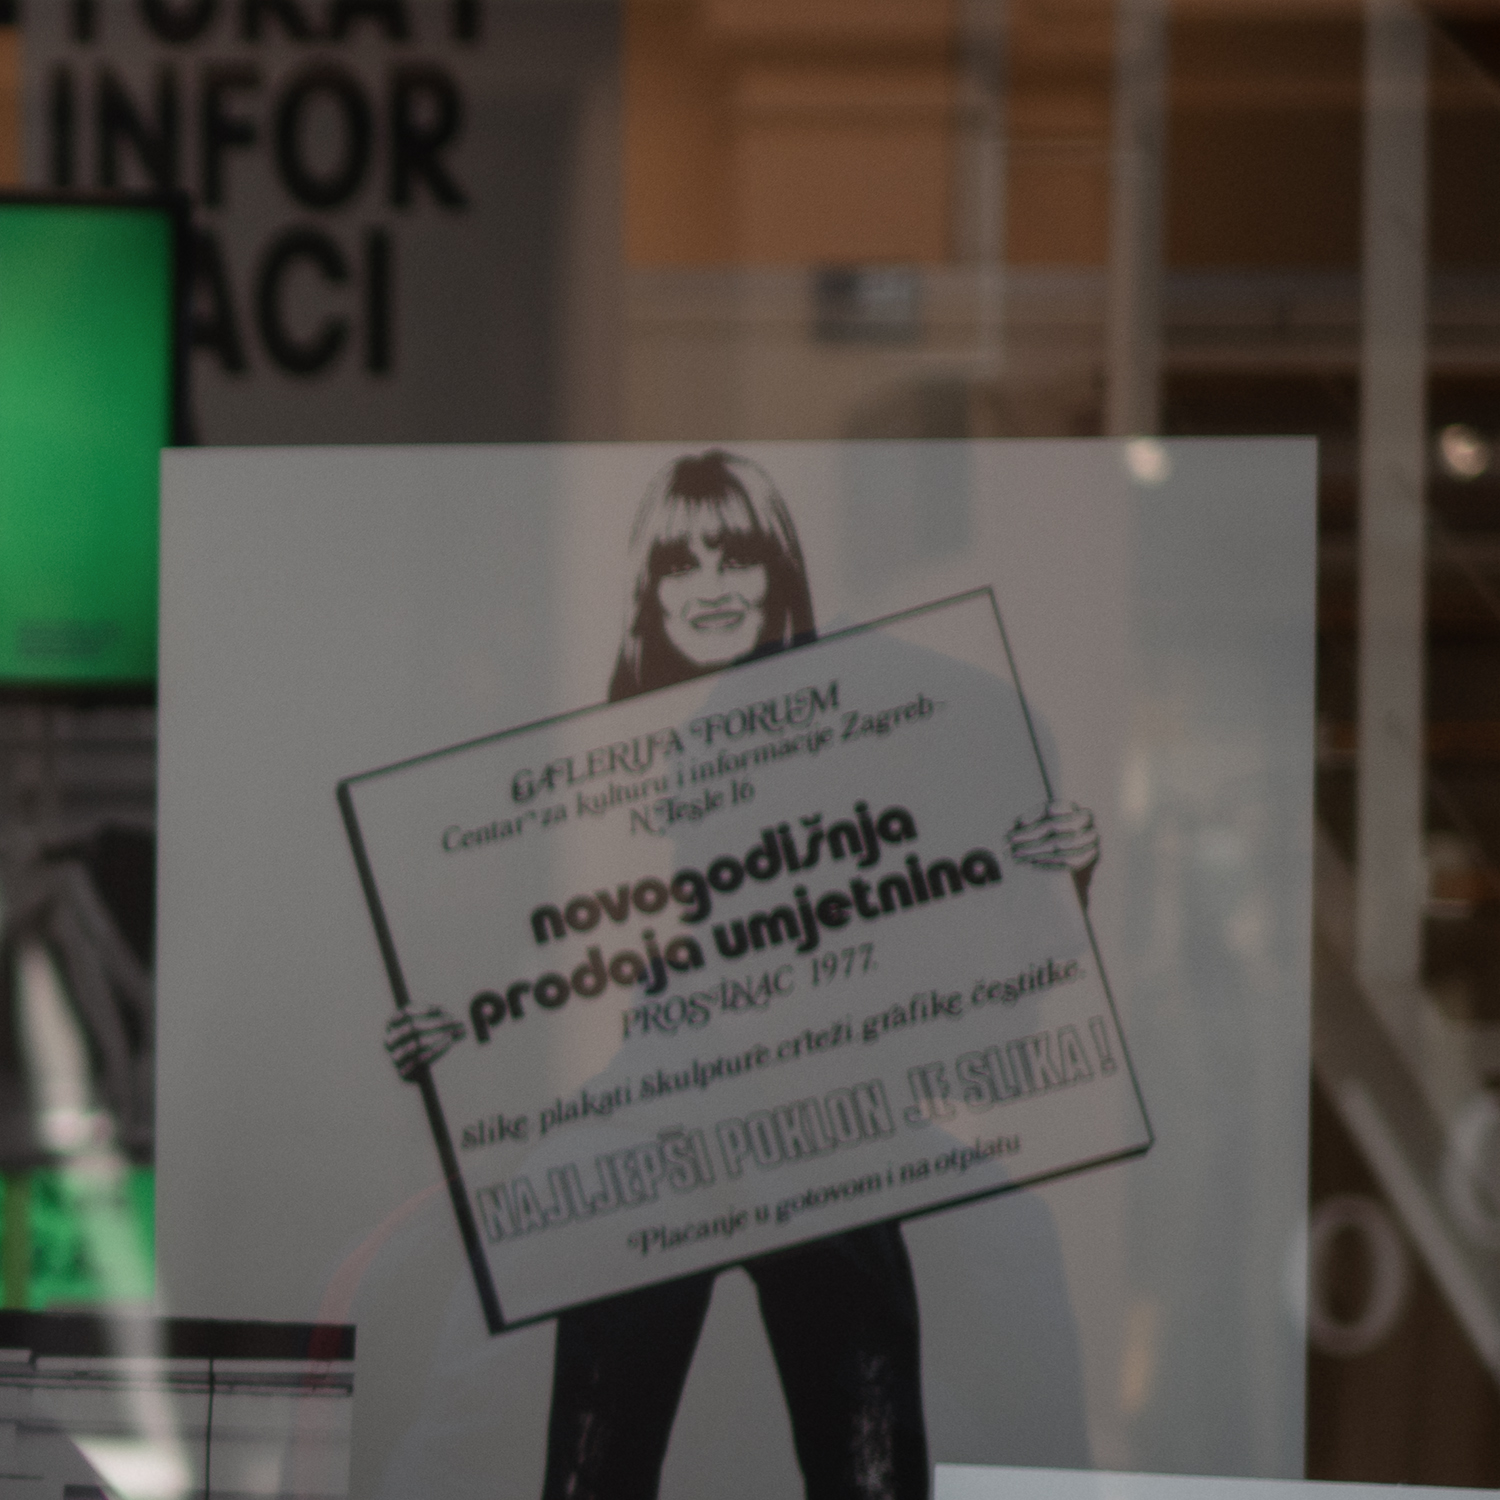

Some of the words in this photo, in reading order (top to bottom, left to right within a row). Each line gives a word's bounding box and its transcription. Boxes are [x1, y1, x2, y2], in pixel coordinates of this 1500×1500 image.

[46, 56, 469, 211] INFOR
[468, 913, 705, 1046] prodaja
[703, 848, 1003, 960] umjetnina
[528, 799, 918, 956] novogodišnja
[477, 1126, 716, 1240] NAJLJEPŠI
[714, 1078, 896, 1179] POKLON
[902, 1061, 950, 1128] JE
